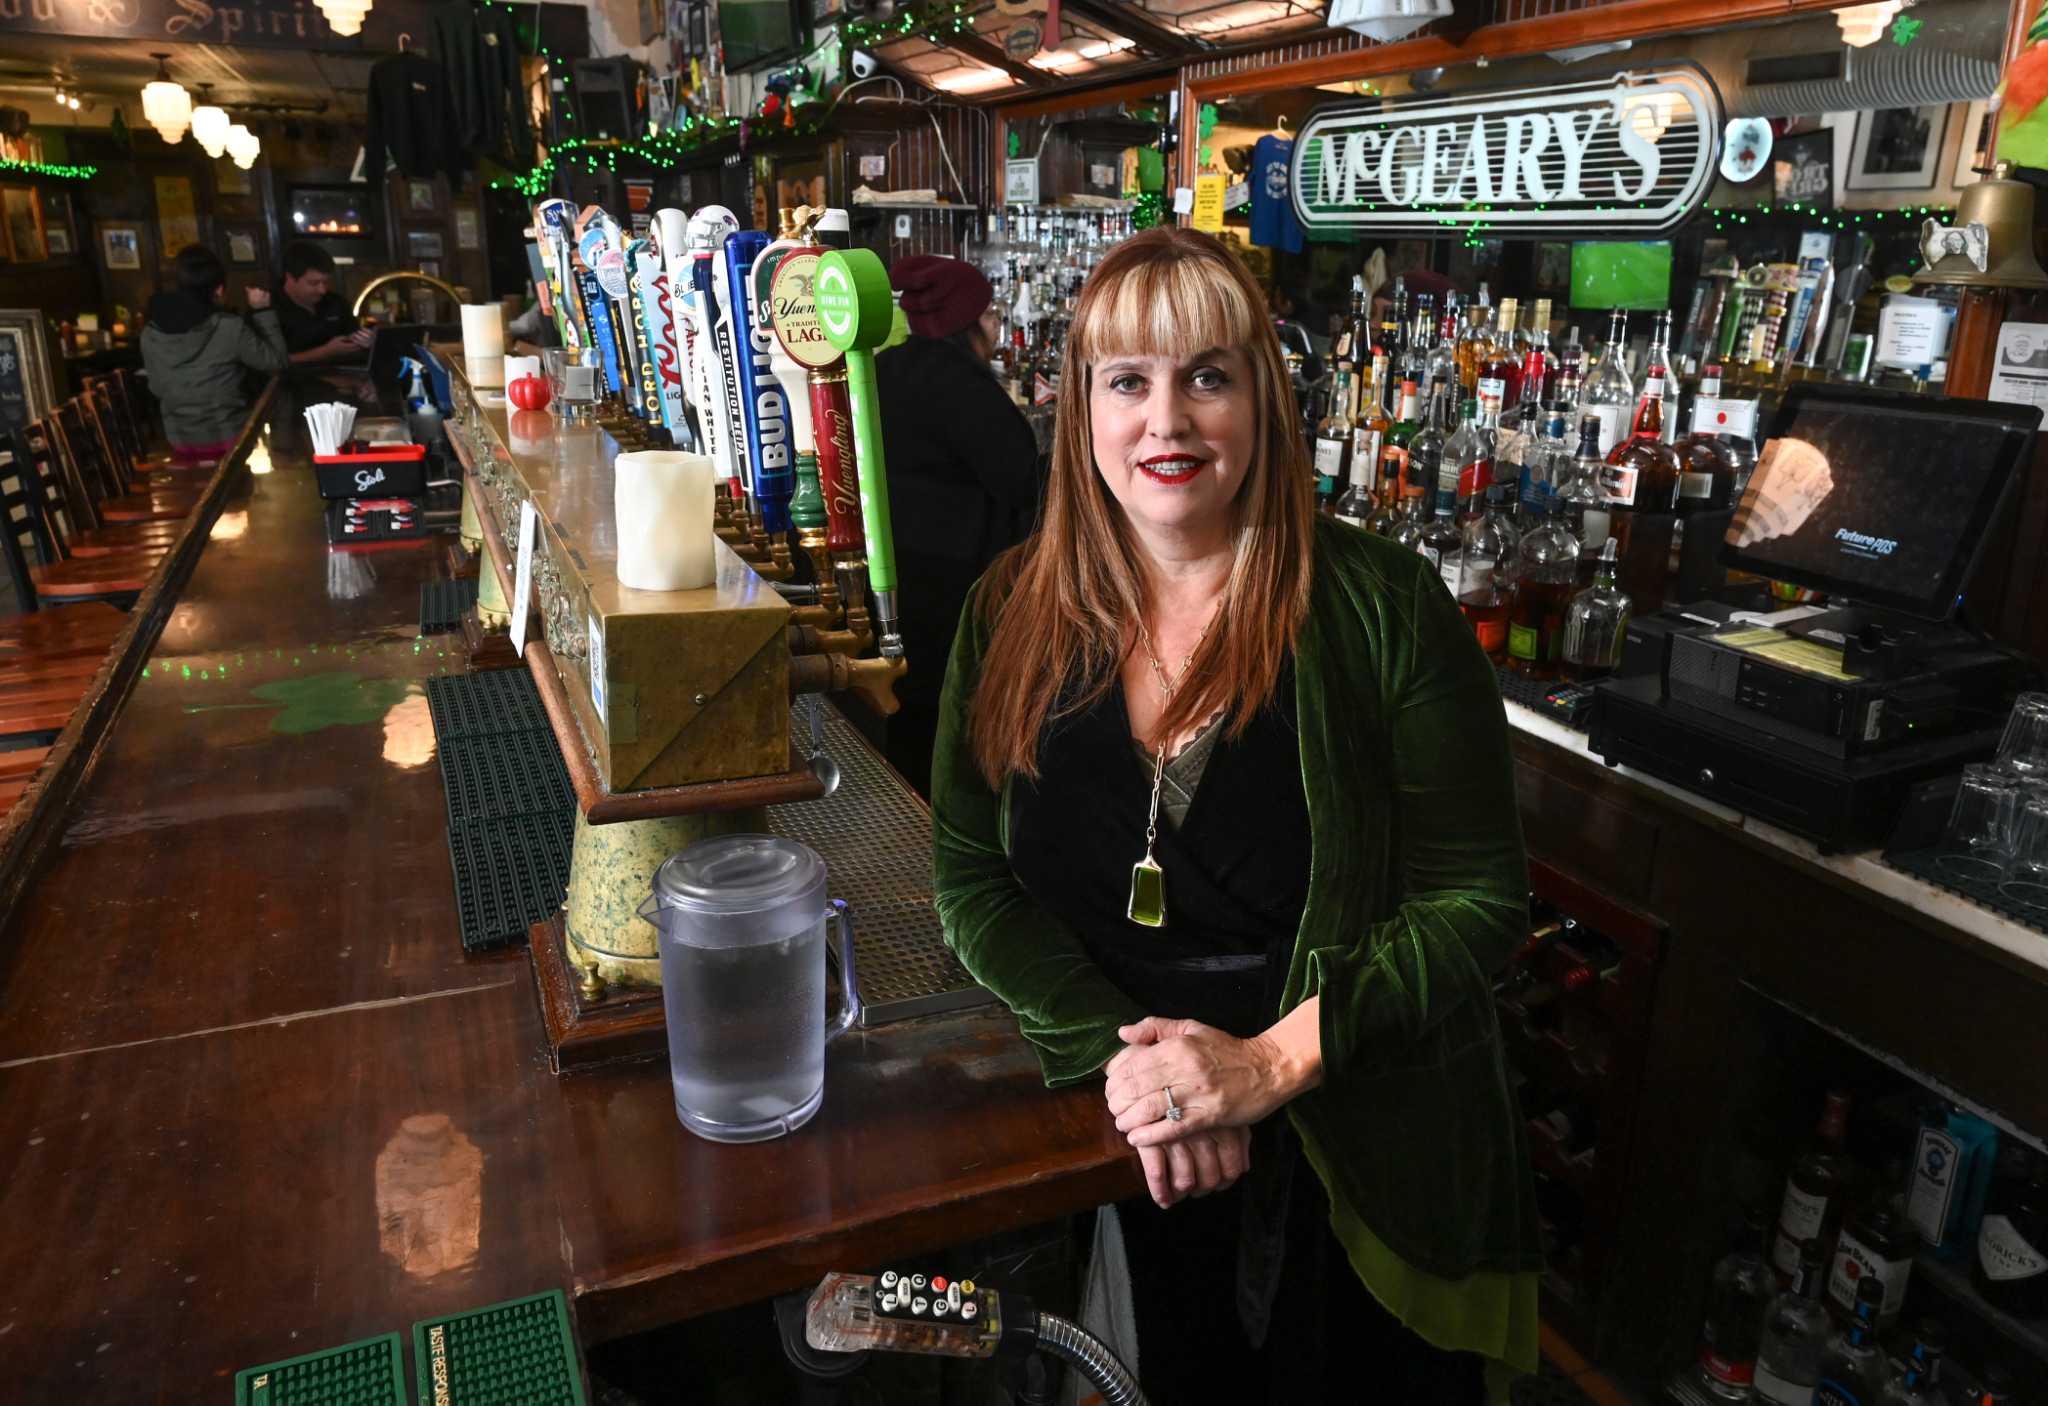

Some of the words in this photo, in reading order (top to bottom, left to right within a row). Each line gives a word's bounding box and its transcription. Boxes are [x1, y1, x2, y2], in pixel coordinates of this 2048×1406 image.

[166, 0, 324, 43] Spiri
[745, 275, 782, 387] LIG
[786, 327, 827, 343] LAG
[641, 361, 663, 425] LORD
[666, 391, 681, 400] LIG
[719, 331, 740, 416] RESTITUTION
[733, 421, 746, 456] NEIPA
[704, 409, 717, 455] WHITE
[757, 391, 789, 469] BUD
[825, 408, 861, 515] Yuengling
